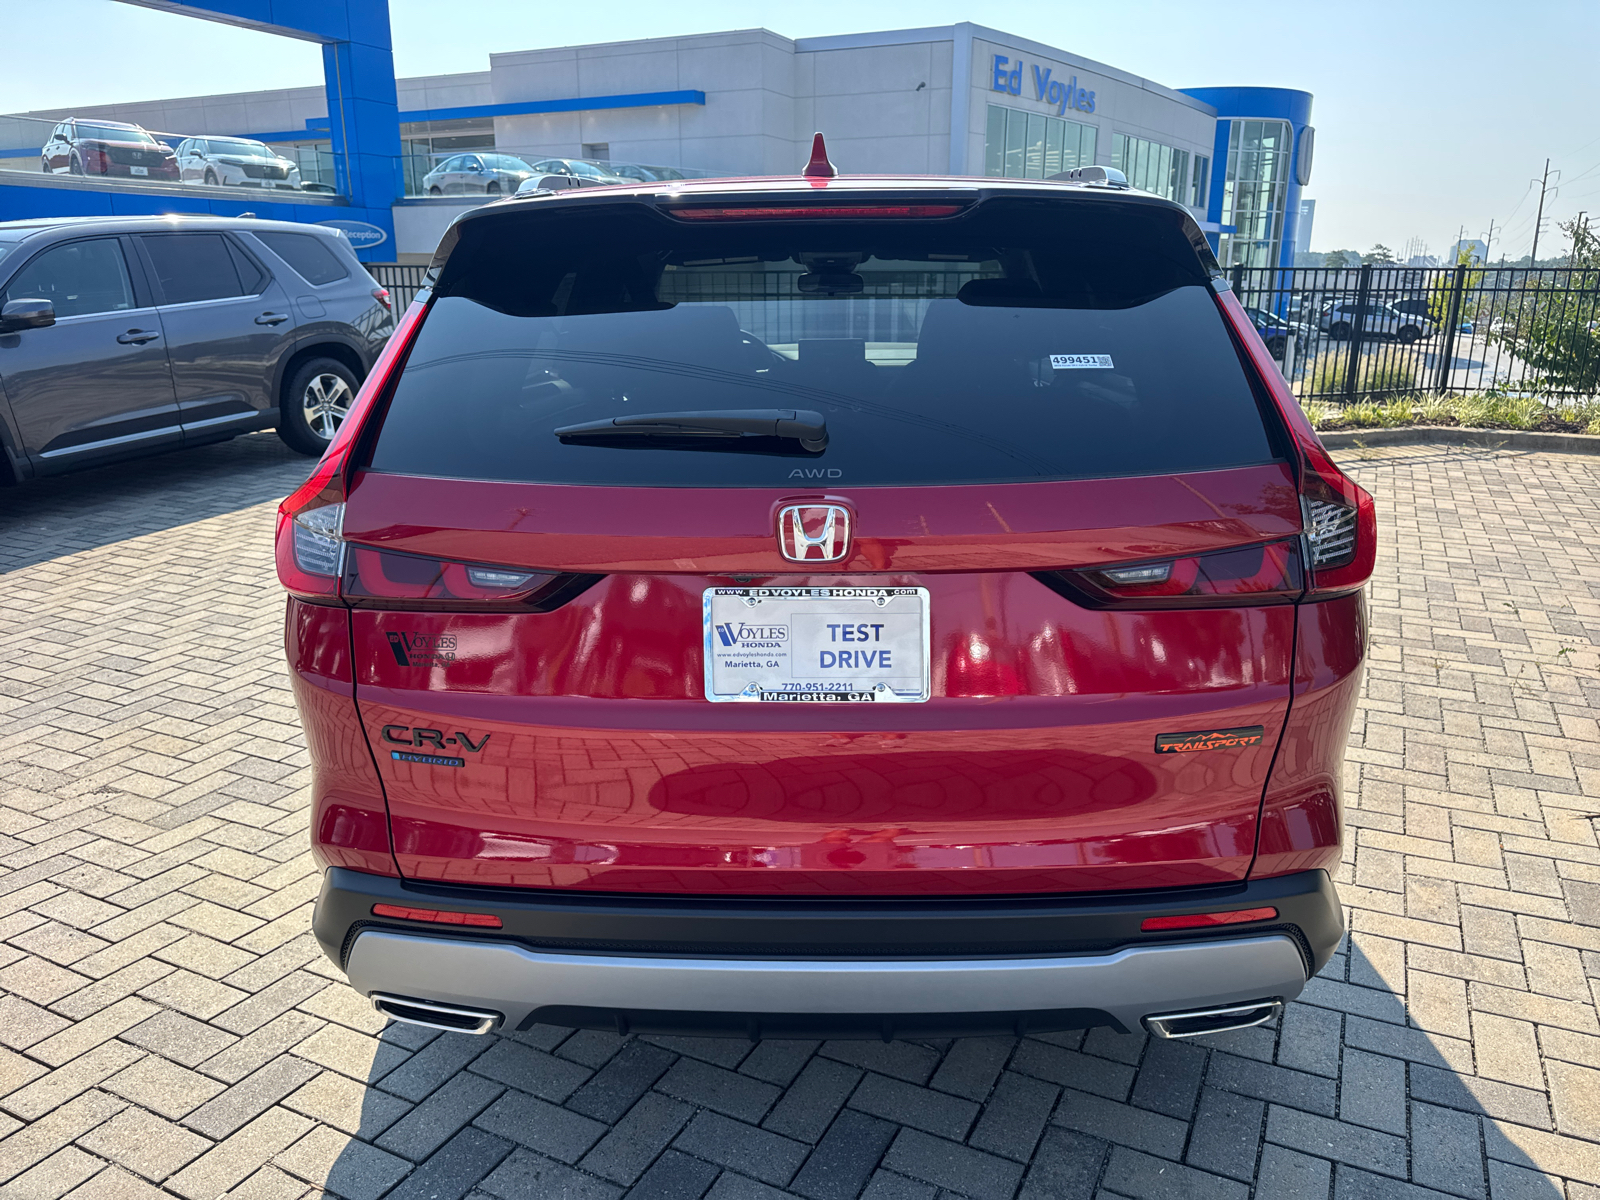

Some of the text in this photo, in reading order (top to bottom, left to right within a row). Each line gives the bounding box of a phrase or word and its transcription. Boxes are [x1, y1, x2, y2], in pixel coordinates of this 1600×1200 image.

[993, 54, 1096, 116] Ed Voyles
[1052, 356, 1098, 364] 499451
[788, 468, 842, 479] AWD
[832, 589, 888, 597] HONDA
[724, 622, 786, 645] VOYLES
[826, 623, 885, 642] TEST
[401, 631, 456, 652] VOYLES
[724, 660, 780, 669] Marietta, GA
[819, 650, 892, 669] DRIVE
[781, 682, 854, 691] 770-951-2211
[763, 692, 873, 701] Marietta, GA
[381, 724, 491, 753] CR-V
[1160, 735, 1261, 752] TRAILSPORT
[401, 754, 460, 766] HYBRID
